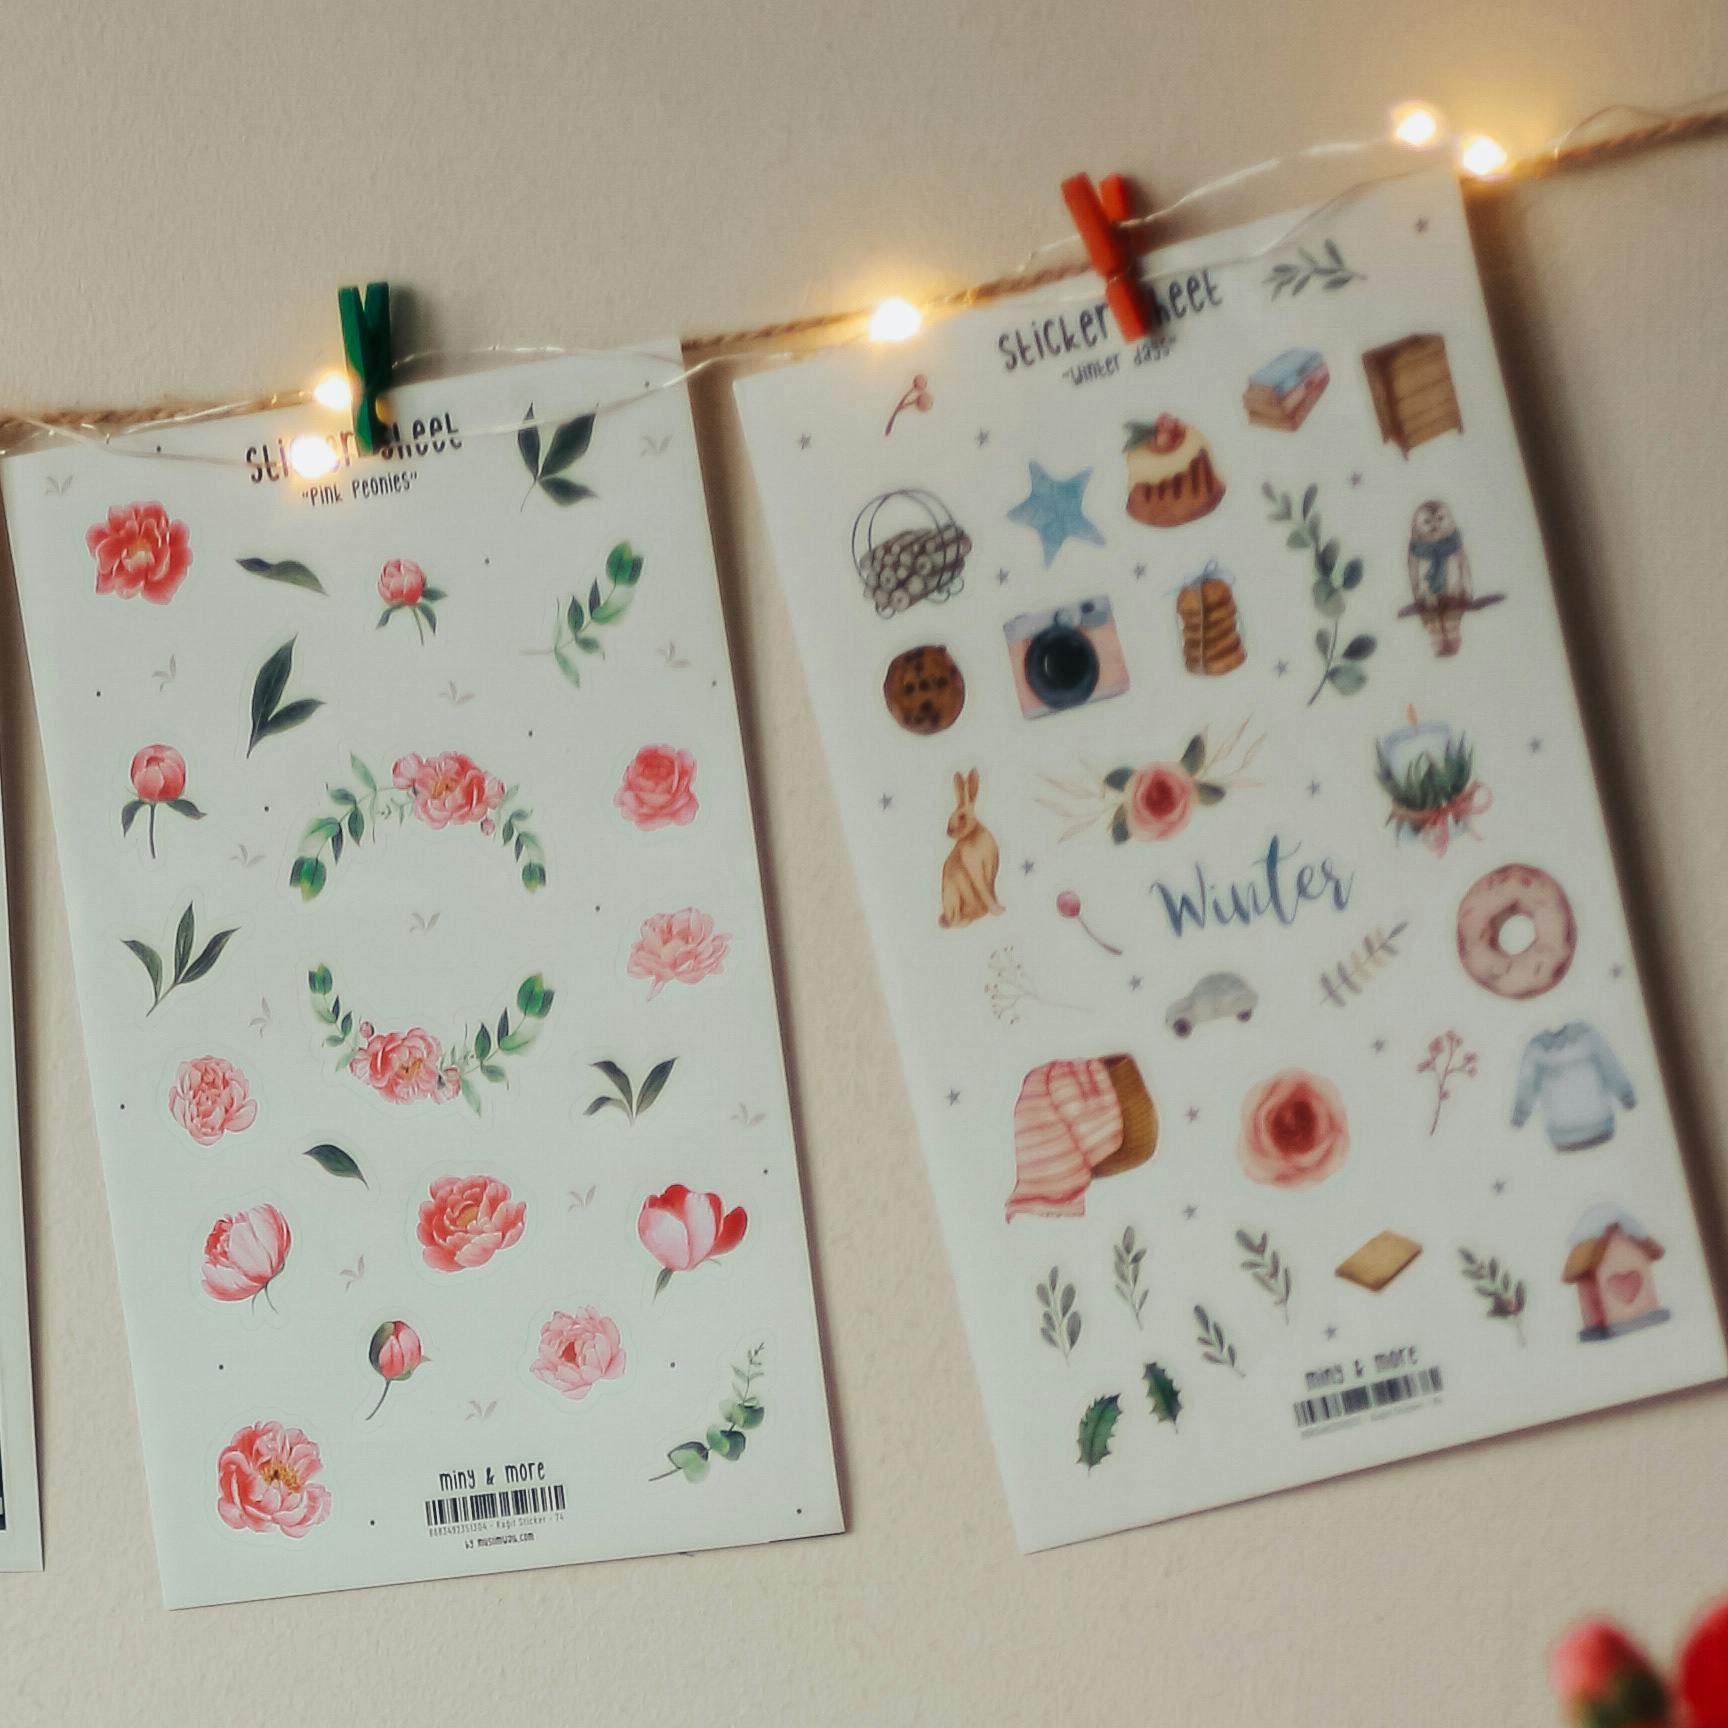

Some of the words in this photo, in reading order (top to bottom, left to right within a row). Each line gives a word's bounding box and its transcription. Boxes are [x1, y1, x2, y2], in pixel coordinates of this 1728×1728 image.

[998, 302, 1110, 371] Sticker
[246, 431, 358, 483] Stir
[1149, 835, 1354, 937] Winter
[439, 1469, 476, 1492] miny
[486, 1467, 495, 1485] &
[505, 1461, 545, 1483] more
[519, 1516, 546, 1527] Sticker
